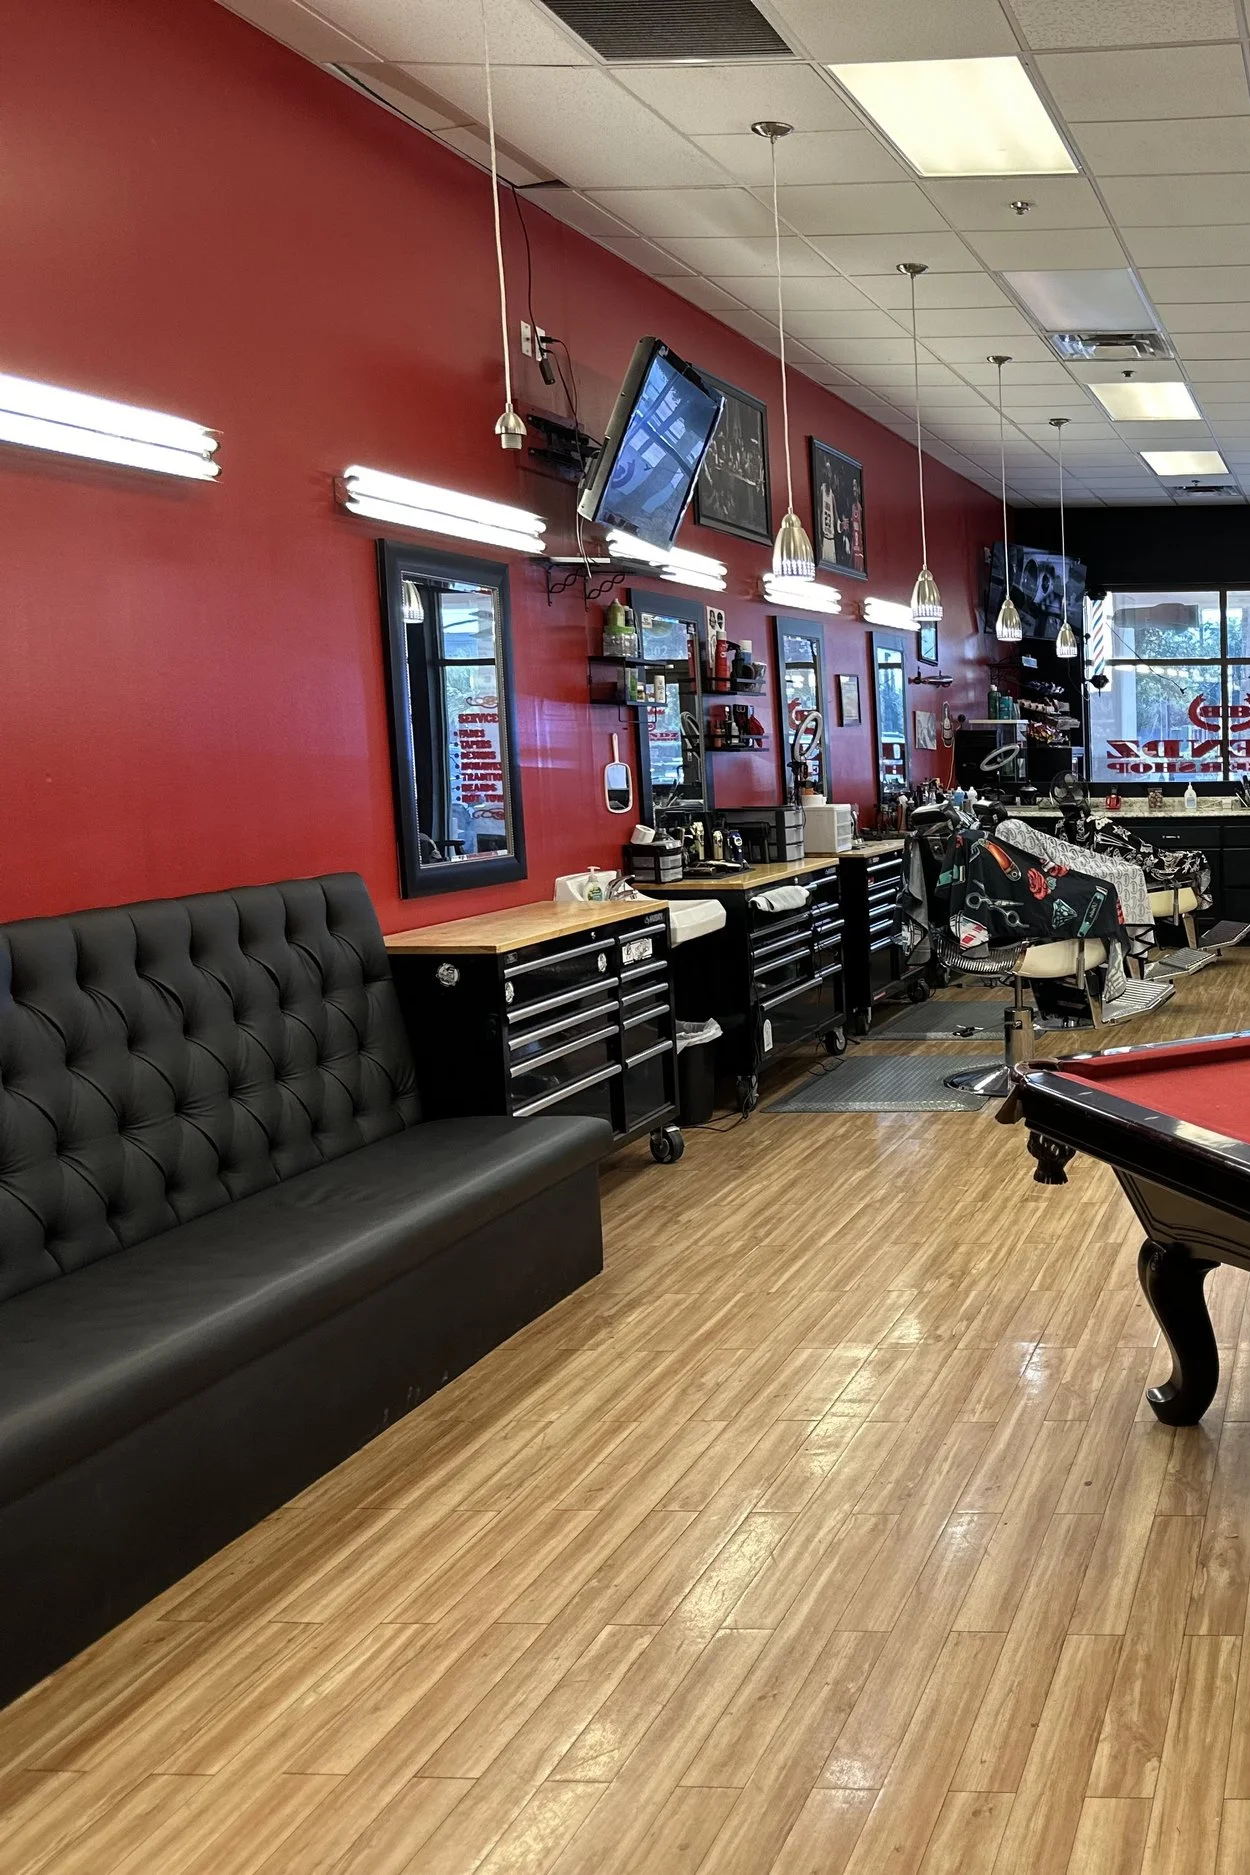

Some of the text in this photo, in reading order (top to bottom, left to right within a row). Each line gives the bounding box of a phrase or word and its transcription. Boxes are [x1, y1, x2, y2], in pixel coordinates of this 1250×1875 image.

[459, 729, 485, 738] FADES
[460, 740, 492, 749] TAPERS
[461, 783, 497, 792] BEARDS
